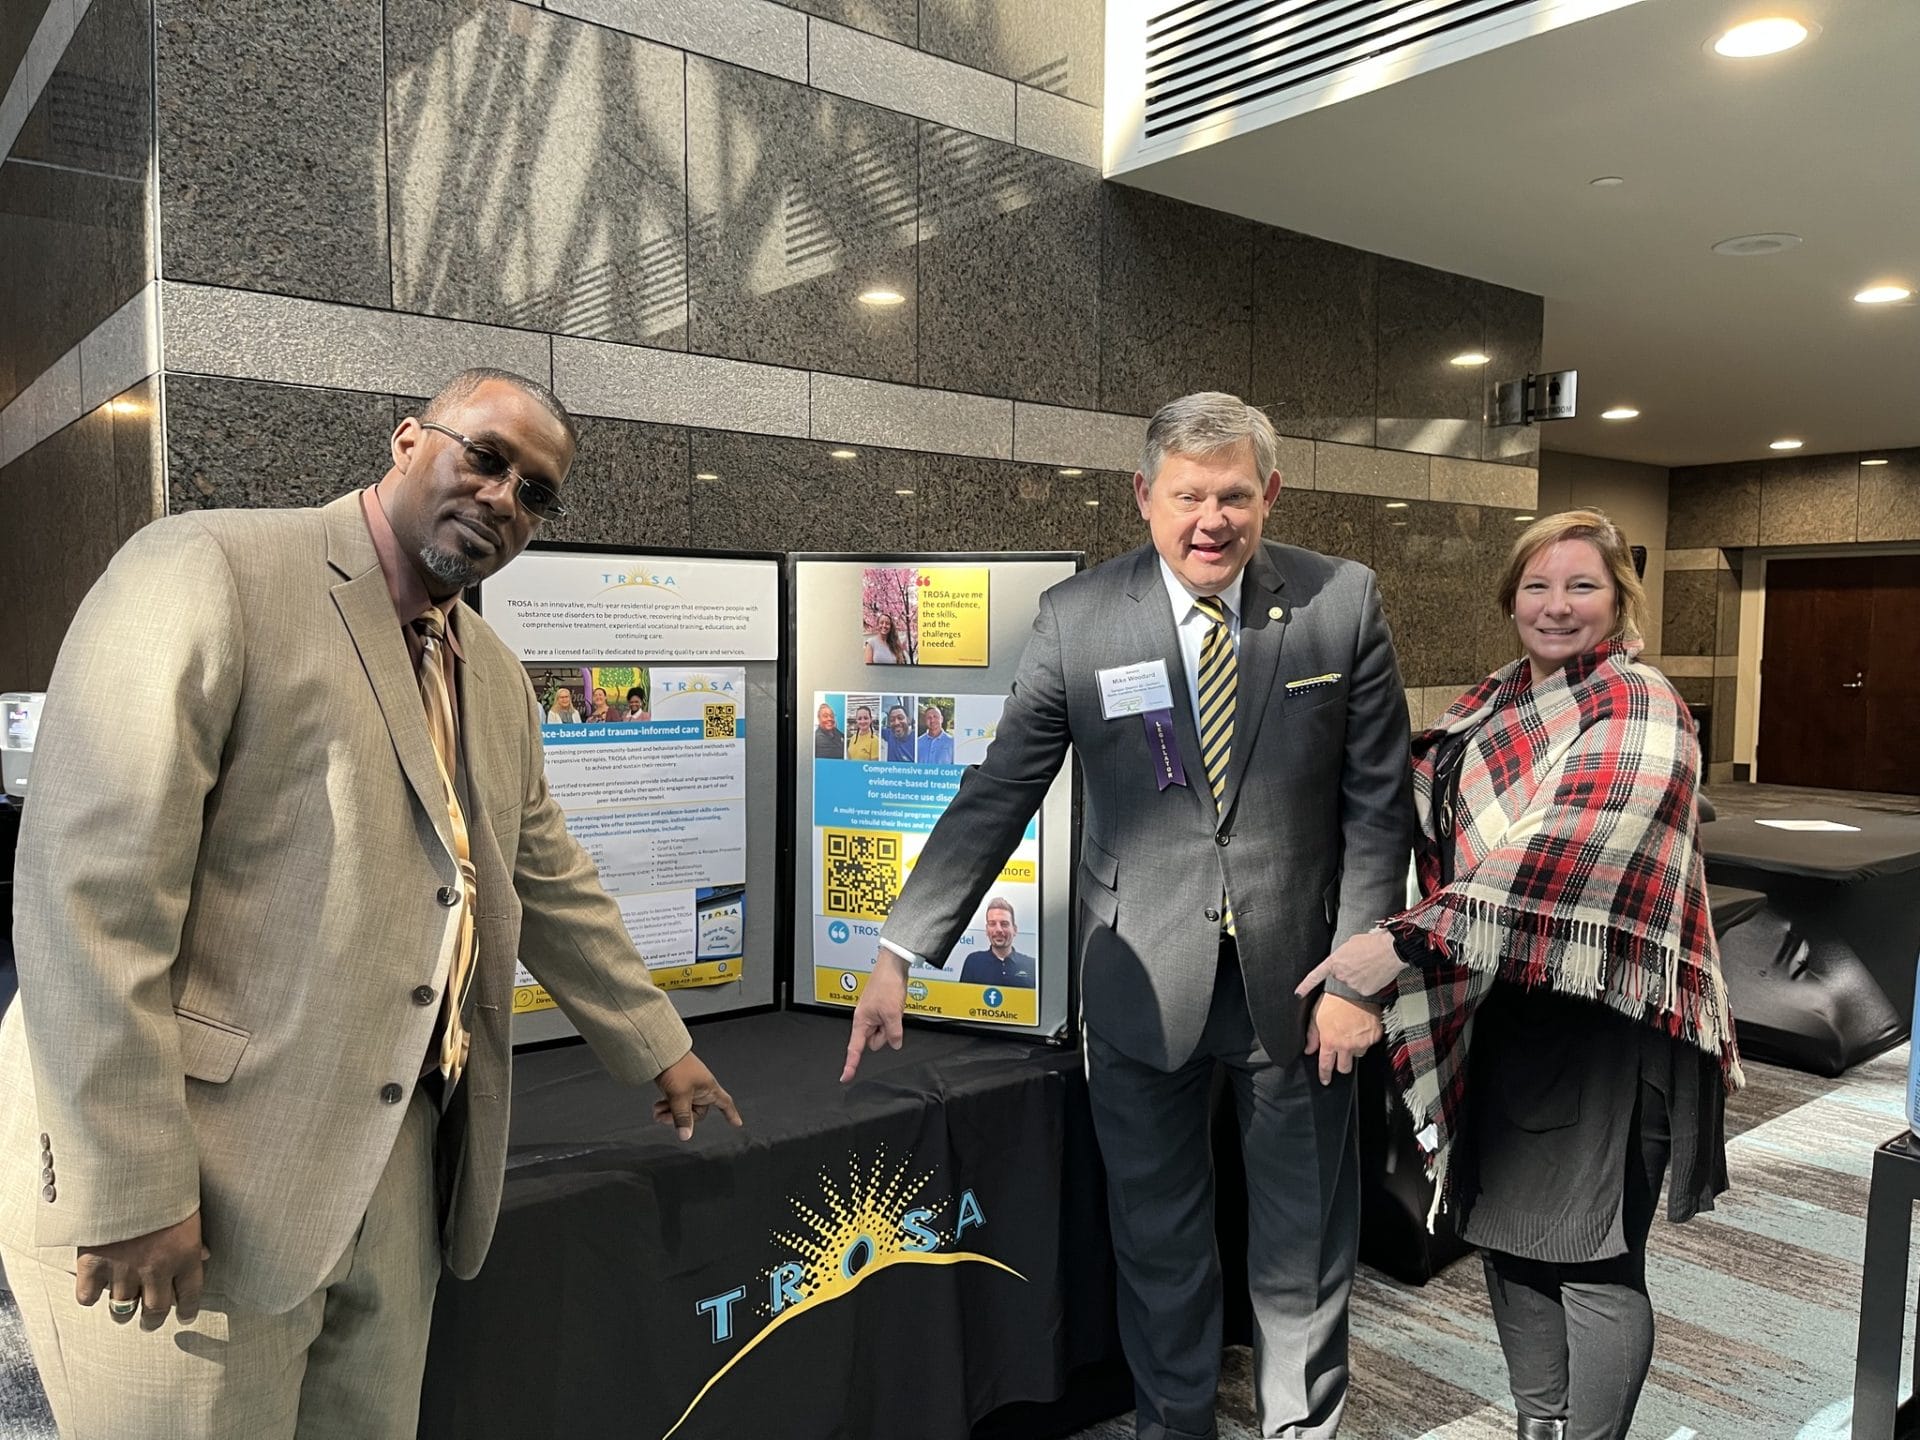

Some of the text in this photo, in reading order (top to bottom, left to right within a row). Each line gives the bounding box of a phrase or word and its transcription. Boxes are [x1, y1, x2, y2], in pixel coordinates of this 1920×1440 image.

[602, 574, 676, 585] TROSA
[936, 601, 980, 609] confidence,
[936, 610, 958, 618] skills,
[522, 621, 573, 630] comprehensive
[922, 630, 961, 639] challenges
[582, 648, 604, 656] facility
[662, 681, 734, 691] TROSA
[588, 727, 605, 736] and
[608, 725, 680, 736] trauma-informed
[1155, 721, 1173, 778] LEGISLATOR
[862, 764, 923, 777] Comprehensive
[923, 766, 939, 776] and
[868, 777, 929, 788] evidence-based
[867, 790, 879, 799] for
[880, 790, 920, 801] substance
[853, 925, 880, 936] TROS
[968, 1008, 1018, 1019] @TROSAinc
[696, 1188, 986, 1344] TROSA
